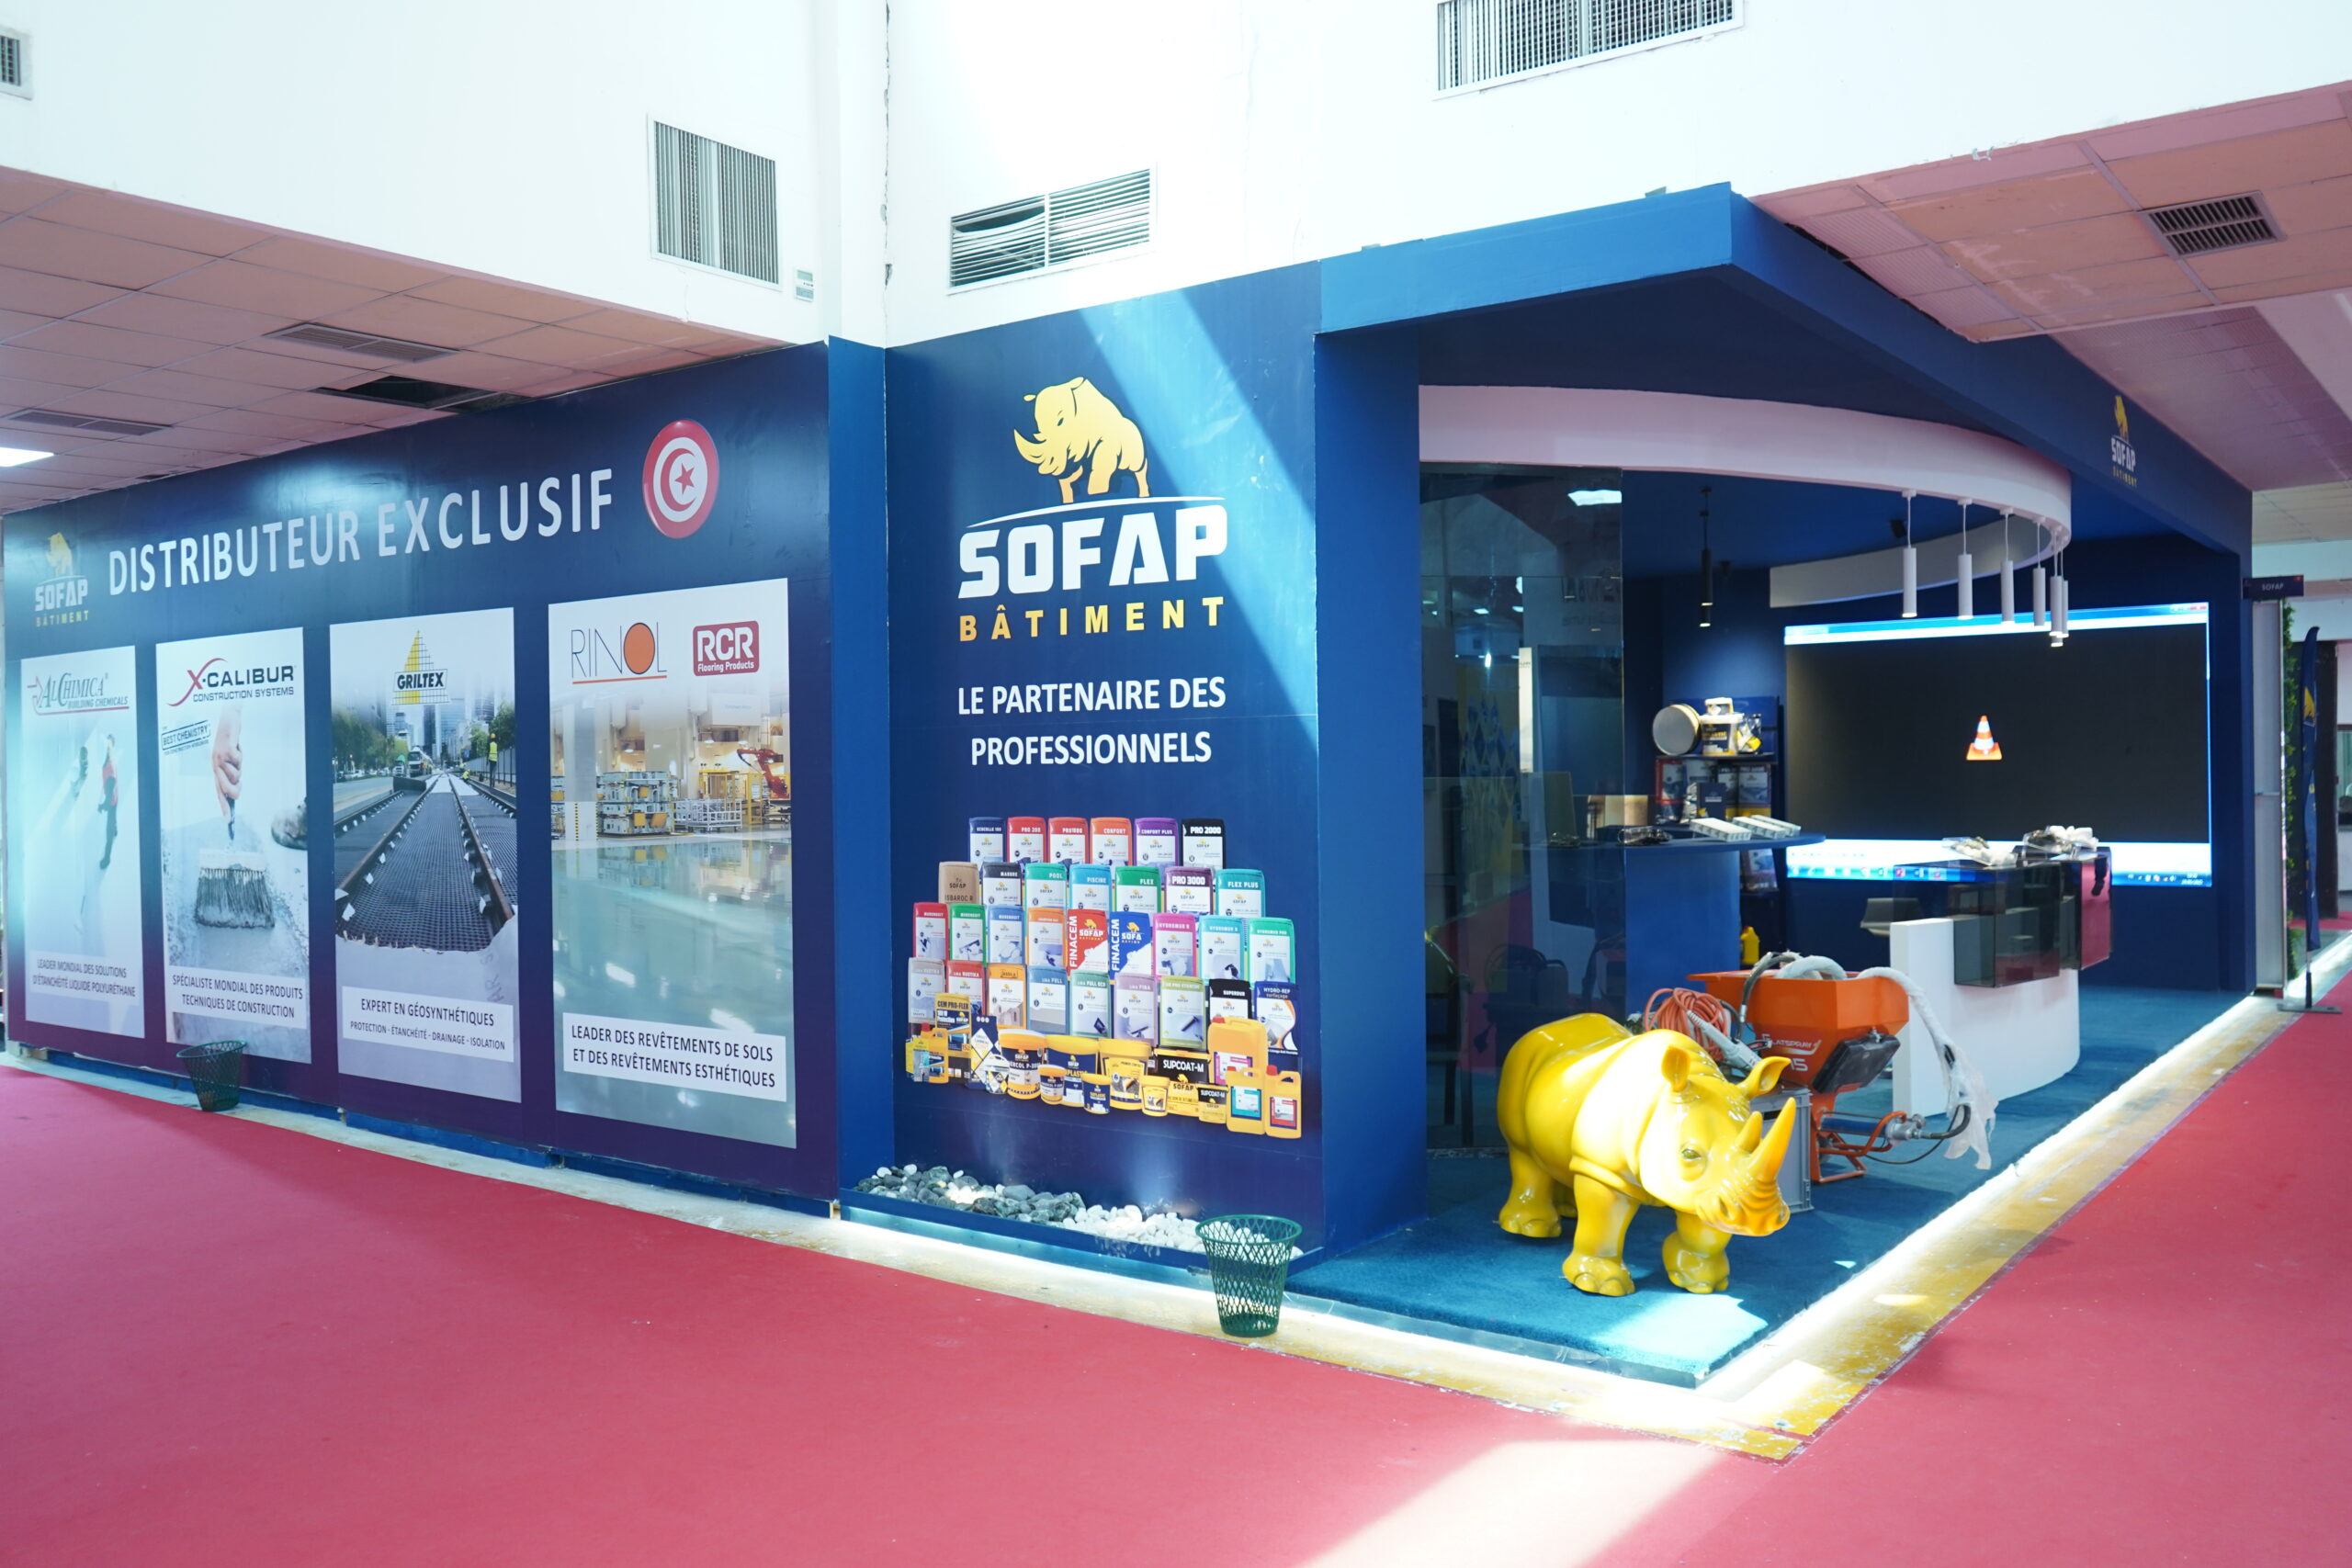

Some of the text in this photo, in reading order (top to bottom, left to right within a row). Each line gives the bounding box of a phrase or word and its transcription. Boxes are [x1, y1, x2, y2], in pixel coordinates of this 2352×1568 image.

[2111, 437, 2136, 472] SOFAP
[108, 468, 612, 596] DISTRIBUTEUR EXCLUSIF
[957, 504, 1227, 599] SOFAP
[35, 579, 88, 612] SOFAP
[2262, 582, 2284, 592] SOFAP
[959, 596, 1224, 641] BÂTIMENT
[571, 622, 667, 678] RINOL
[696, 626, 754, 661] RCR
[397, 672, 444, 690] GRILTEX
[697, 660, 755, 673] Flooring Products
[95, 696, 129, 706] CHEMICALS
[193, 687, 294, 702] CONSTRUCTION SYSTEMS
[958, 677, 1226, 715] LE PARTENAIRE DES
[971, 731, 1212, 765] PROFESSIONNELS
[1172, 876, 1205, 885] PRO 3000
[1069, 916, 1078, 967] FINACEM
[1111, 919, 1120, 971] FINACEM
[38, 959, 127, 978] LEADER MONDIAL DES SOLUTIONS
[69, 979, 90, 992] LIQUIDE
[172, 973, 303, 999] SPÉCIALISTE MONDIAL DES PRODUITS
[182, 994, 294, 1018] TECHNIQUES DE CONSTRUCTION
[361, 998, 494, 1027] EXPERT EN GÉOSYNTHÉTIQUES
[350, 1021, 386, 1034] PROTECTION
[391, 1025, 427, 1040] ÉTANCHÉITÉ
[432, 1032, 465, 1045] DRAINAGE
[470, 1037, 505, 1050] ISOLATION
[571, 1025, 773, 1062] LEADER DES REVÊTEMENTS DE SOLS
[573, 1048, 775, 1088] ET DES REVÊTEMENTS ESTHÉTIQUES
[1163, 1059, 1204, 1073] SUPCOAT-M
